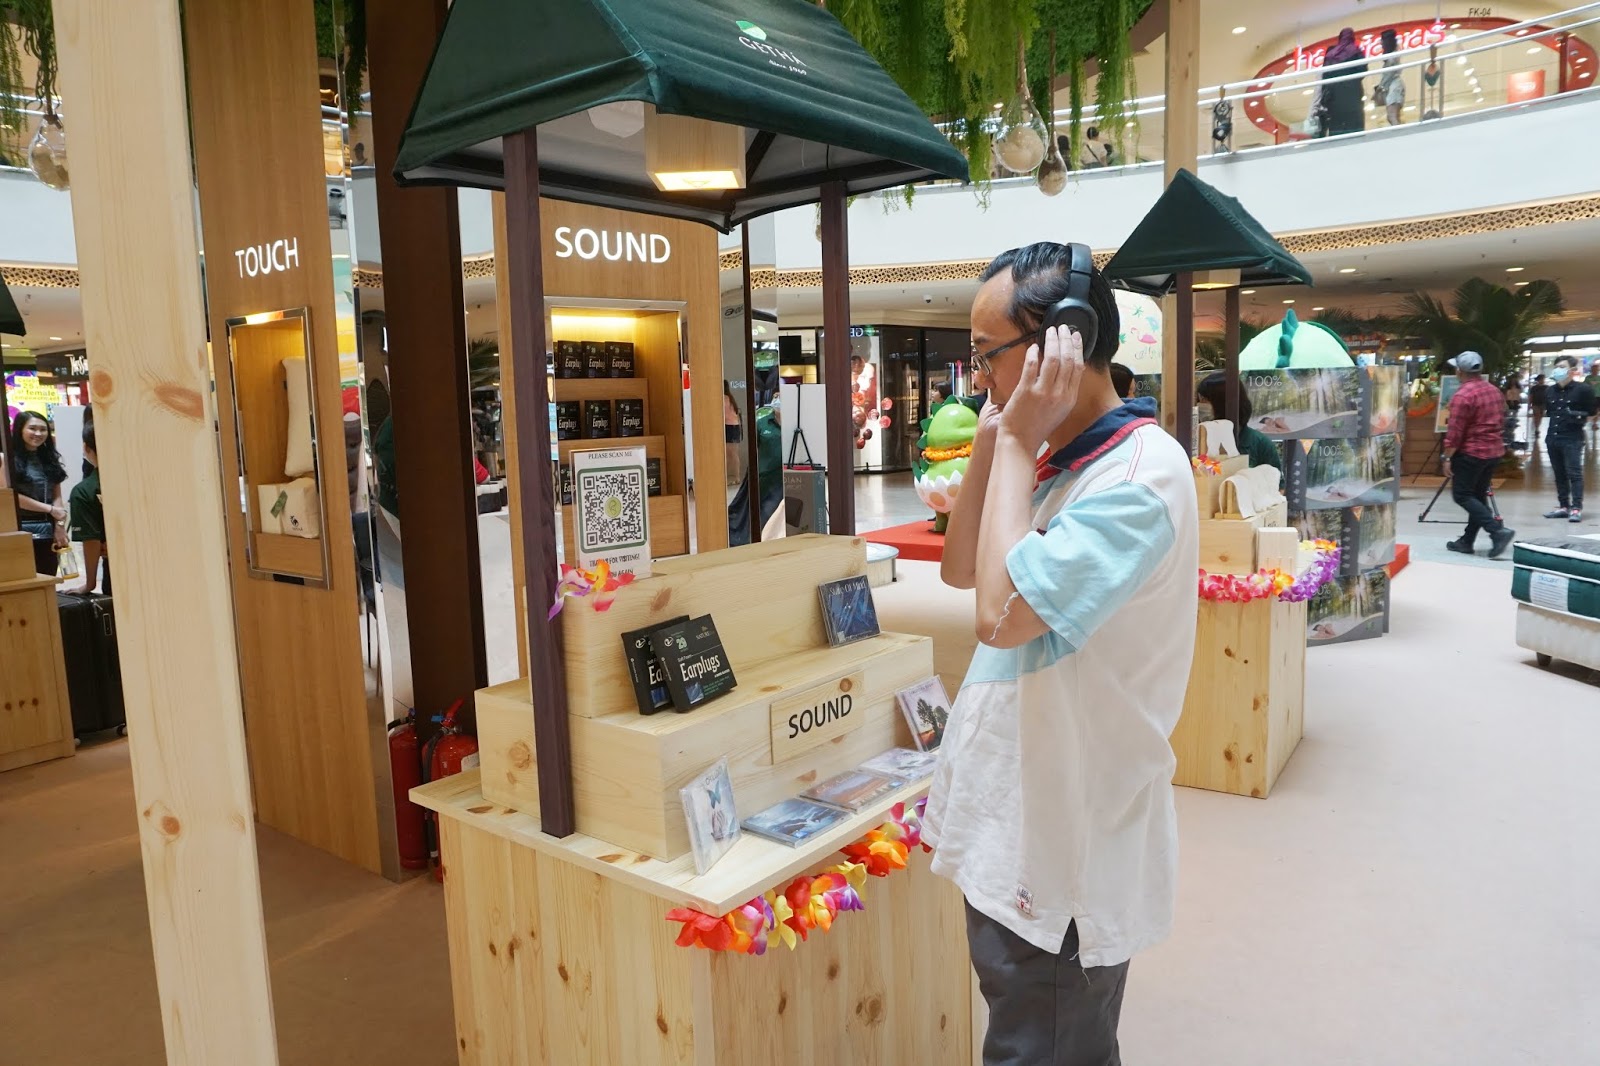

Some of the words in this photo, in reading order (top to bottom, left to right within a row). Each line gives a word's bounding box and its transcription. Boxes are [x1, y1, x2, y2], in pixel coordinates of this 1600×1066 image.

[1468, 7, 1491, 17] FK-04
[555, 226, 671, 263] SOUND
[234, 237, 299, 279] TOUCH
[612, 358, 631, 369] Earplugs
[1249, 375, 1283, 387] 100%
[622, 417, 640, 427] Earplugs
[1319, 444, 1343, 457] 100%
[680, 654, 721, 682] Earplugs
[788, 693, 853, 739] SOUND
